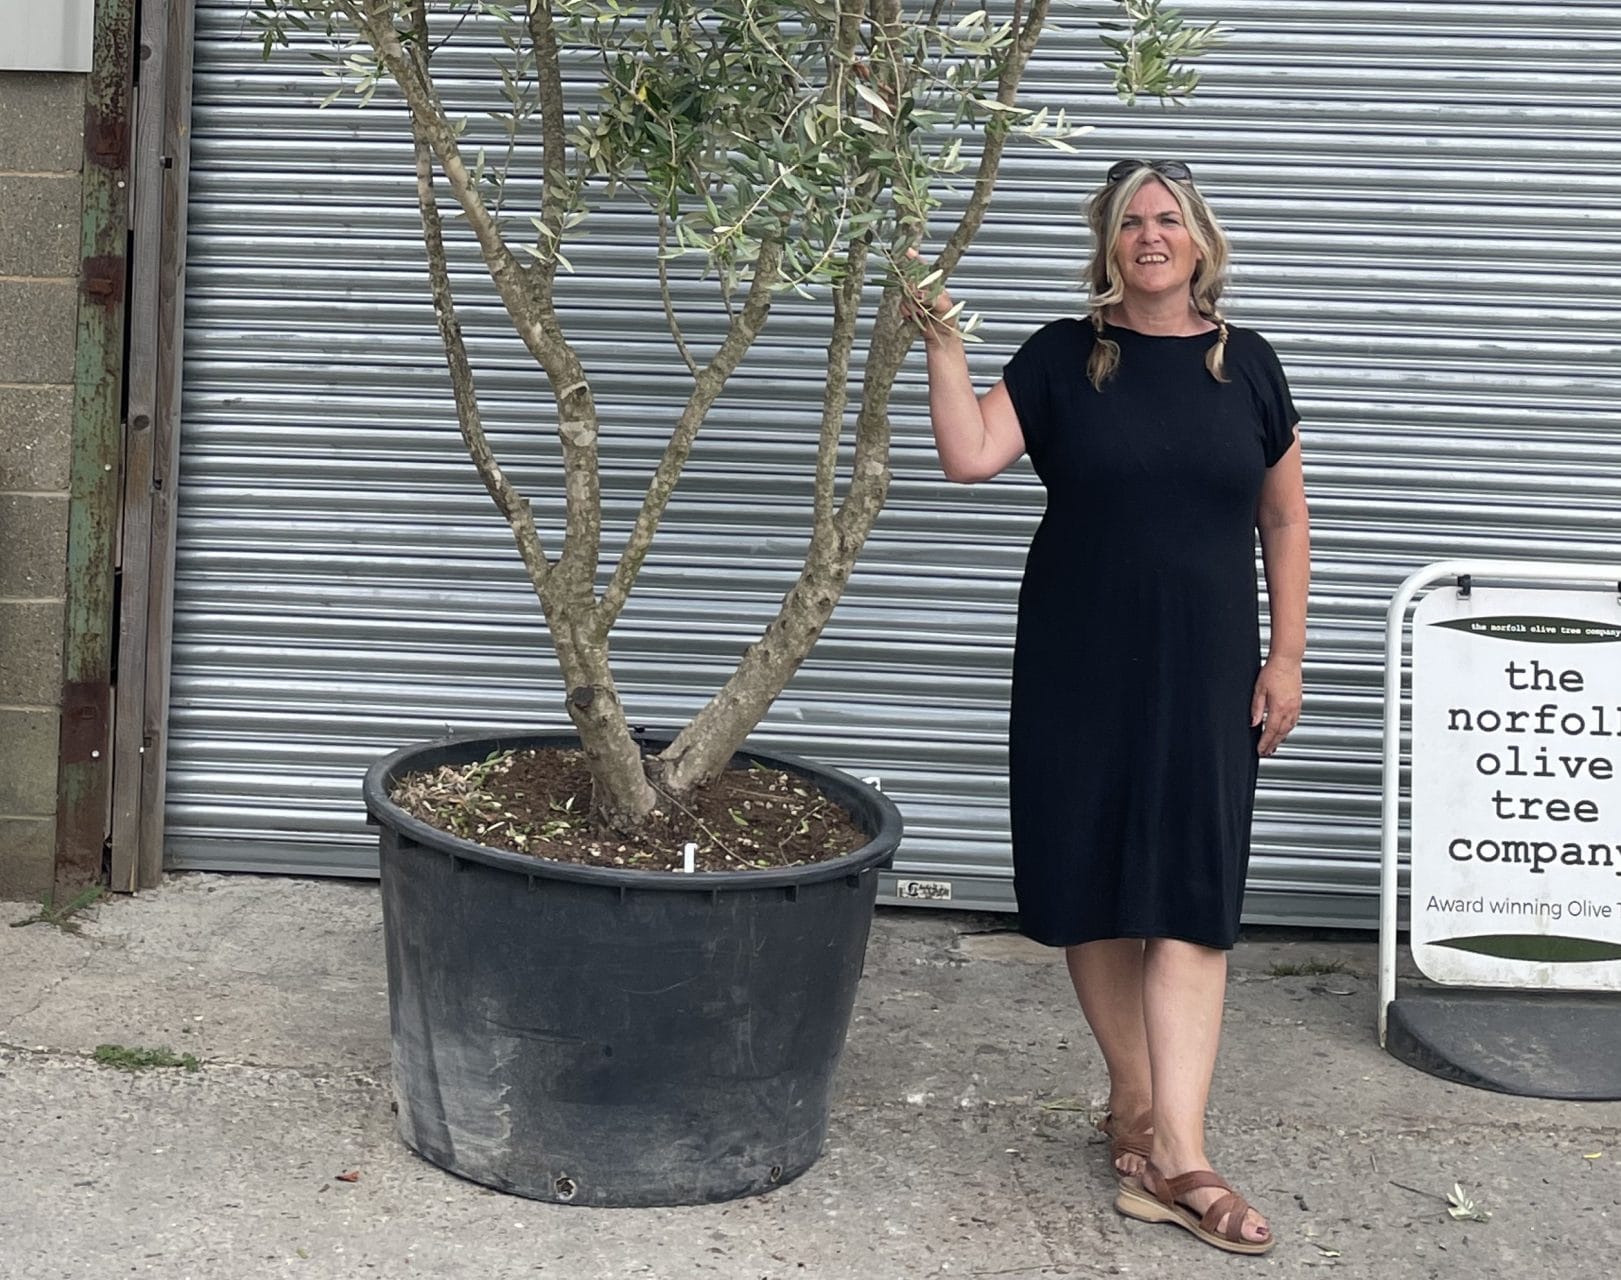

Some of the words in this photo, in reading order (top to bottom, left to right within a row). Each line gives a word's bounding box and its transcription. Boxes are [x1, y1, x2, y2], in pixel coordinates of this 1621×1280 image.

[1471, 623, 1487, 631] the
[1490, 623, 1527, 633] norfolk
[1530, 624, 1557, 634] olive
[1560, 626, 1582, 635] tree
[1505, 661, 1583, 692] the
[1448, 704, 1621, 736] norfol
[1477, 746, 1612, 779] olive
[1492, 790, 1598, 822] tree
[1449, 839, 1621, 876] compan
[1426, 895, 1484, 913] Award
[1489, 897, 1562, 920] winning
[1567, 899, 1612, 918] Olive
